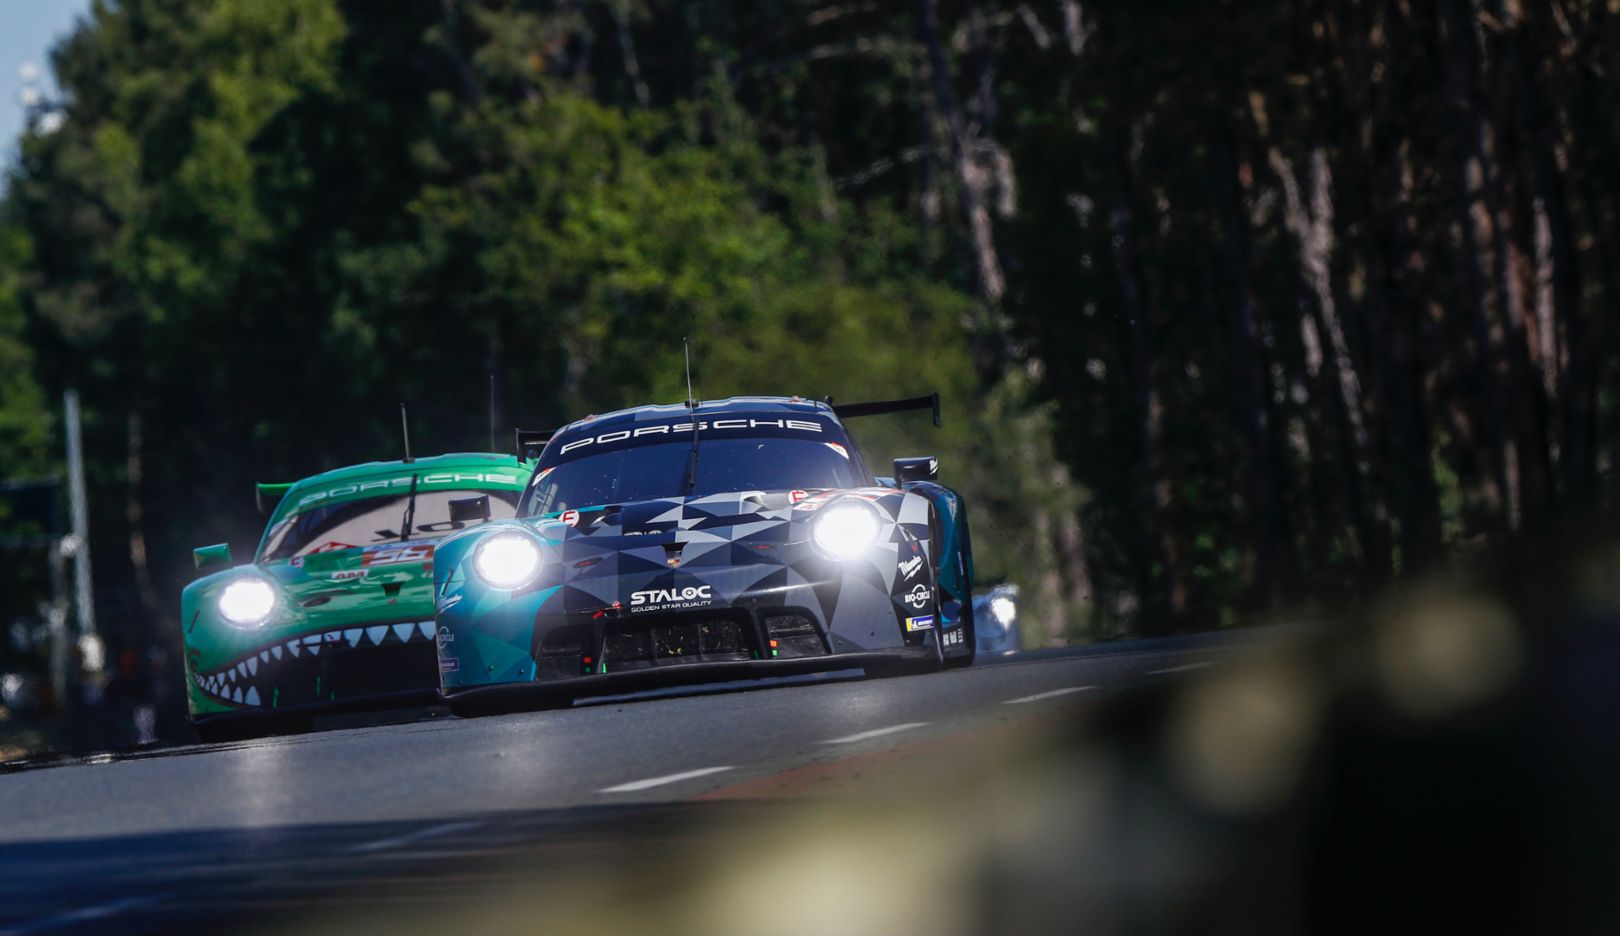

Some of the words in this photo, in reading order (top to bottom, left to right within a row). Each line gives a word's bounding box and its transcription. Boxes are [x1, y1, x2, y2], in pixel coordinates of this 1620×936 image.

[559, 418, 823, 456] PORSCHE
[299, 473, 517, 506] PORSCHE
[630, 585, 712, 605] STALOC
[631, 605, 660, 613] GOLDEN
[682, 600, 712, 608] QUALITY
